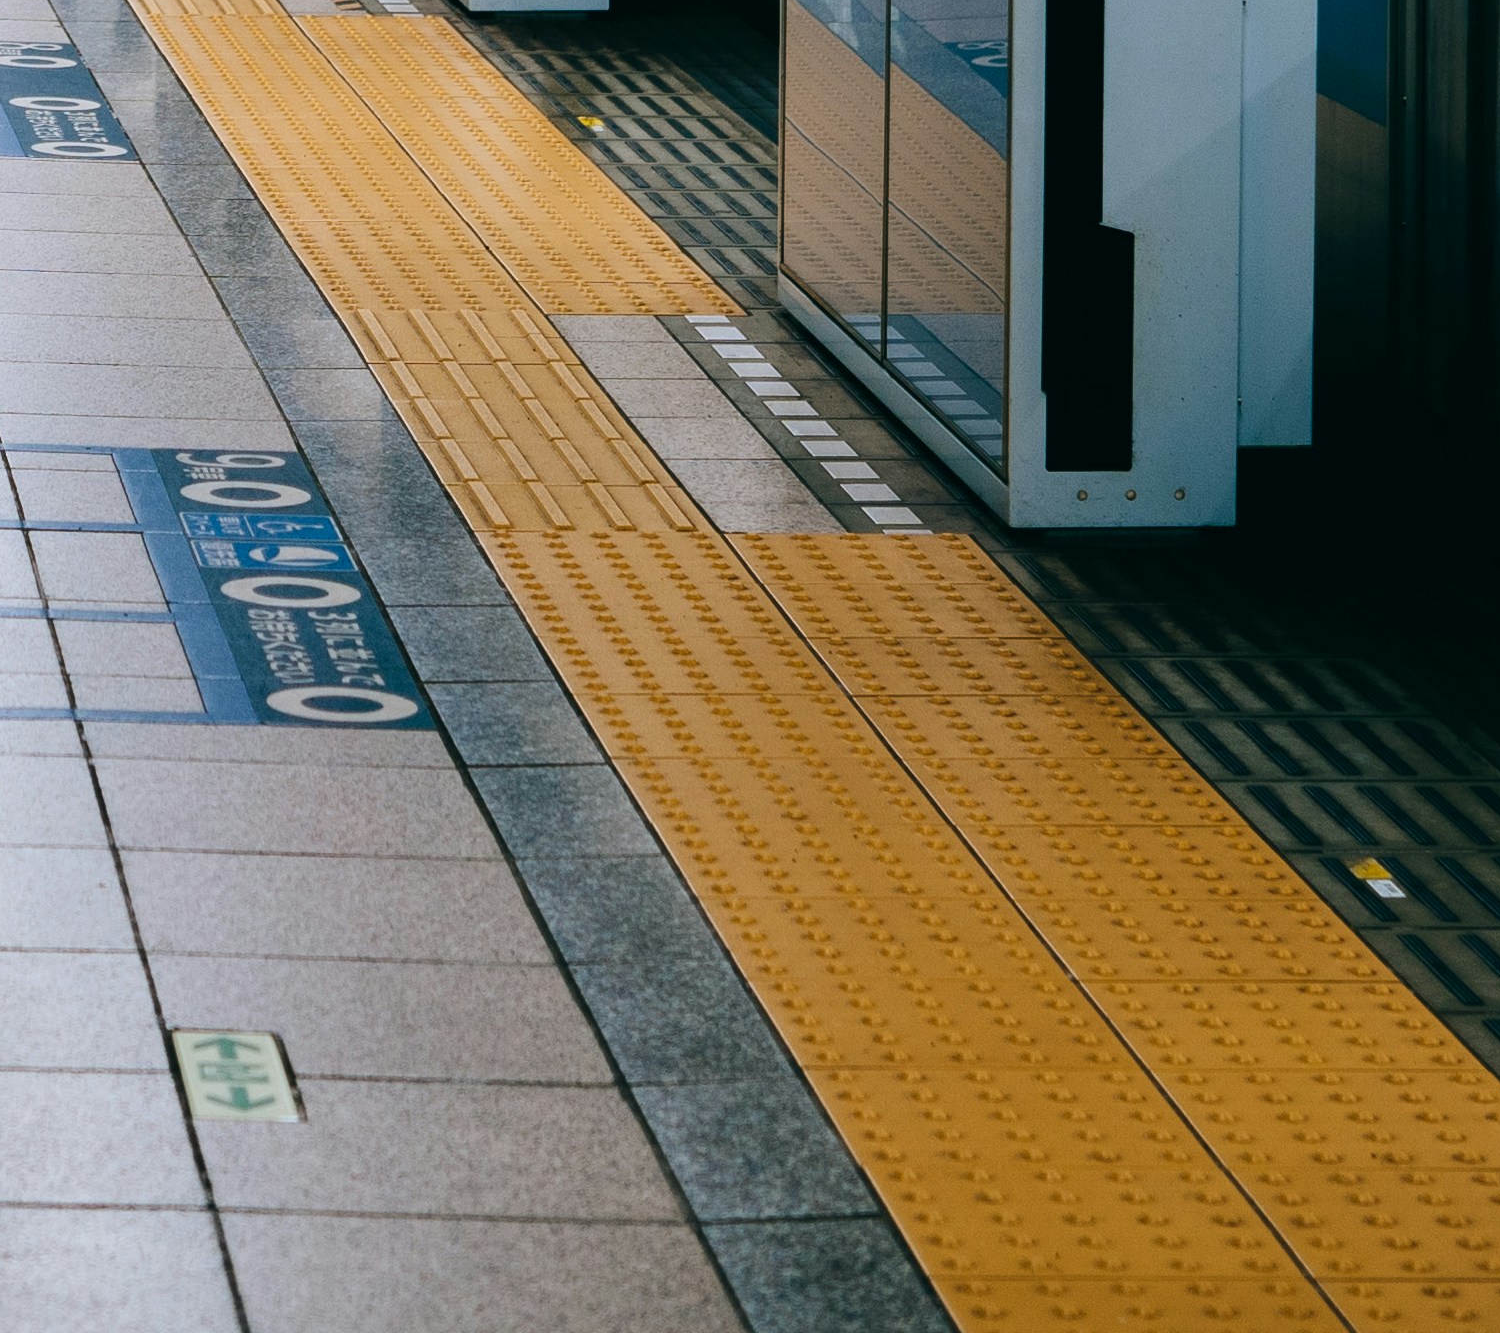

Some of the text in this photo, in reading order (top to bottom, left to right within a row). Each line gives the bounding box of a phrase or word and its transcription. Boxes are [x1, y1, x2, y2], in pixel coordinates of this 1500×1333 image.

[247, 608, 316, 684] お待ちください
[307, 610, 387, 687] 3列に並んで
